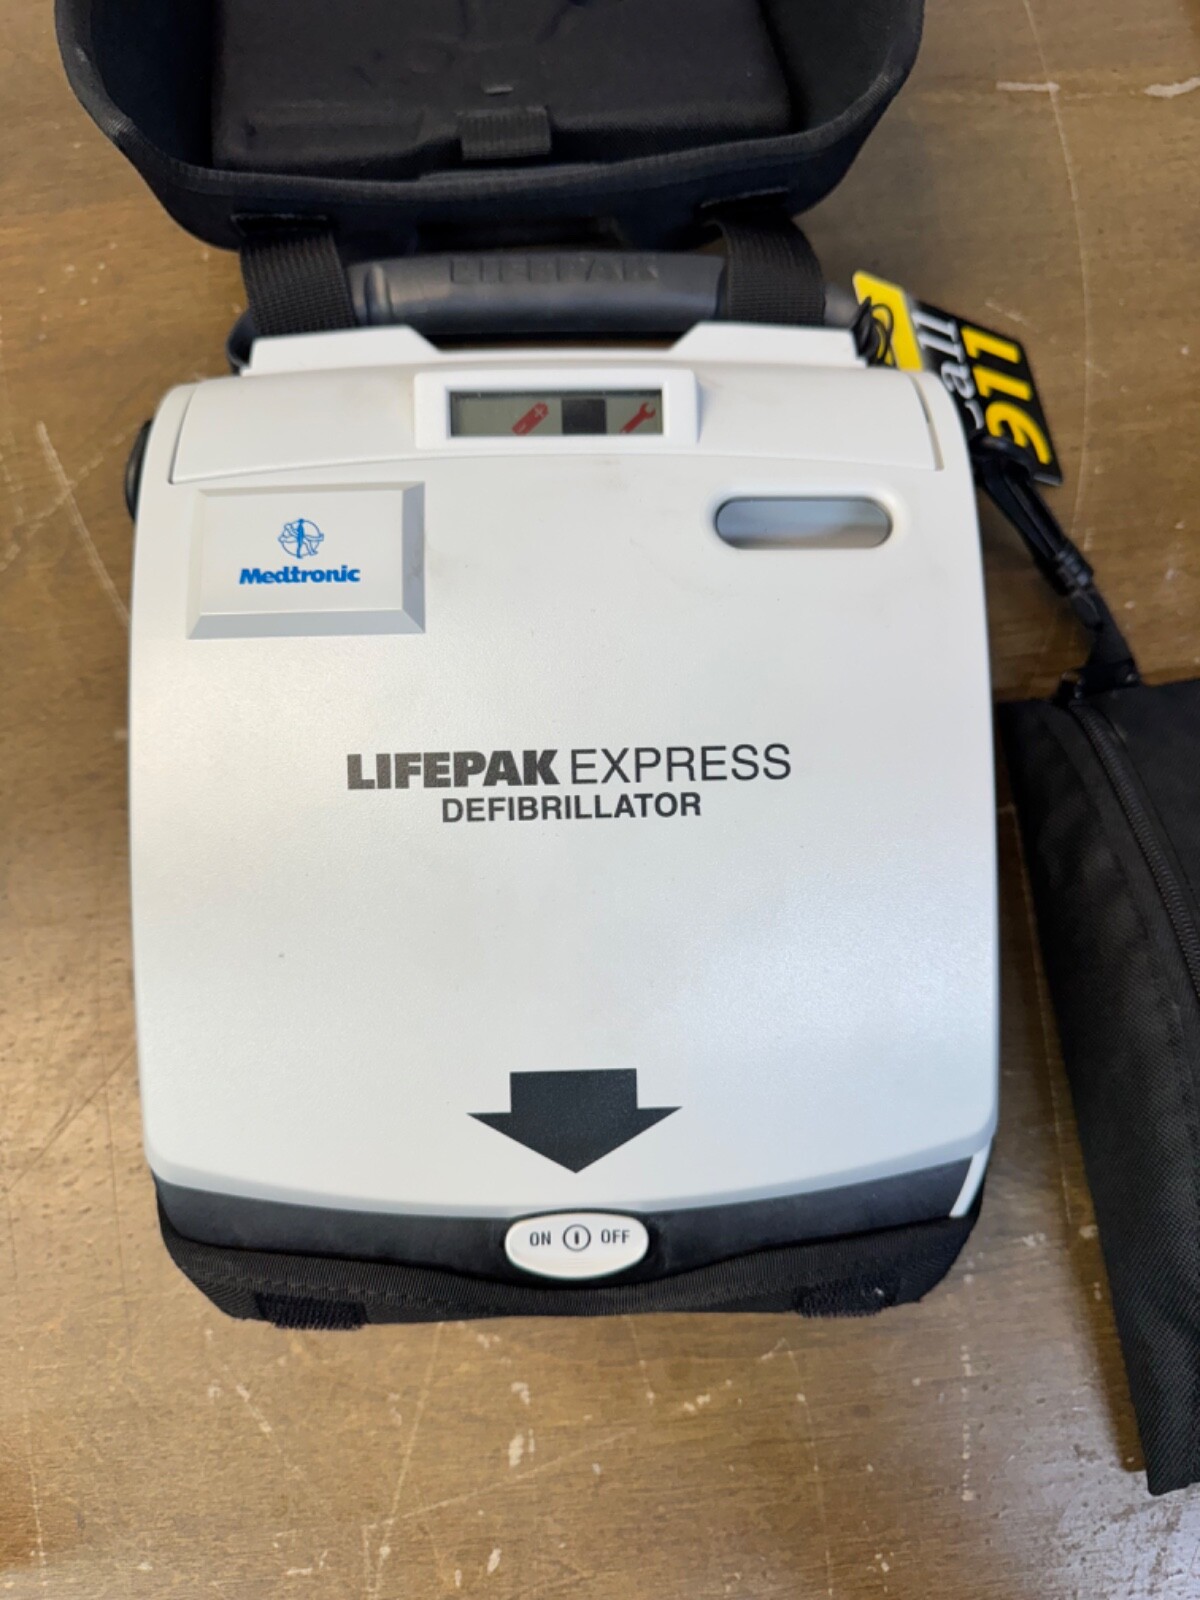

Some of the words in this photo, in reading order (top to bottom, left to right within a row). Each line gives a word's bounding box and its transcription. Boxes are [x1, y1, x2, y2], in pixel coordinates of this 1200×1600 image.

[960, 325, 1052, 466] 911
[239, 565, 361, 585] Medtronic
[346, 748, 560, 790] LIFEPAK
[570, 743, 792, 784] EXPRESS
[442, 791, 702, 823] DEFIBRILLATOR
[529, 1231, 551, 1246] ON
[600, 1229, 631, 1244] OFF
